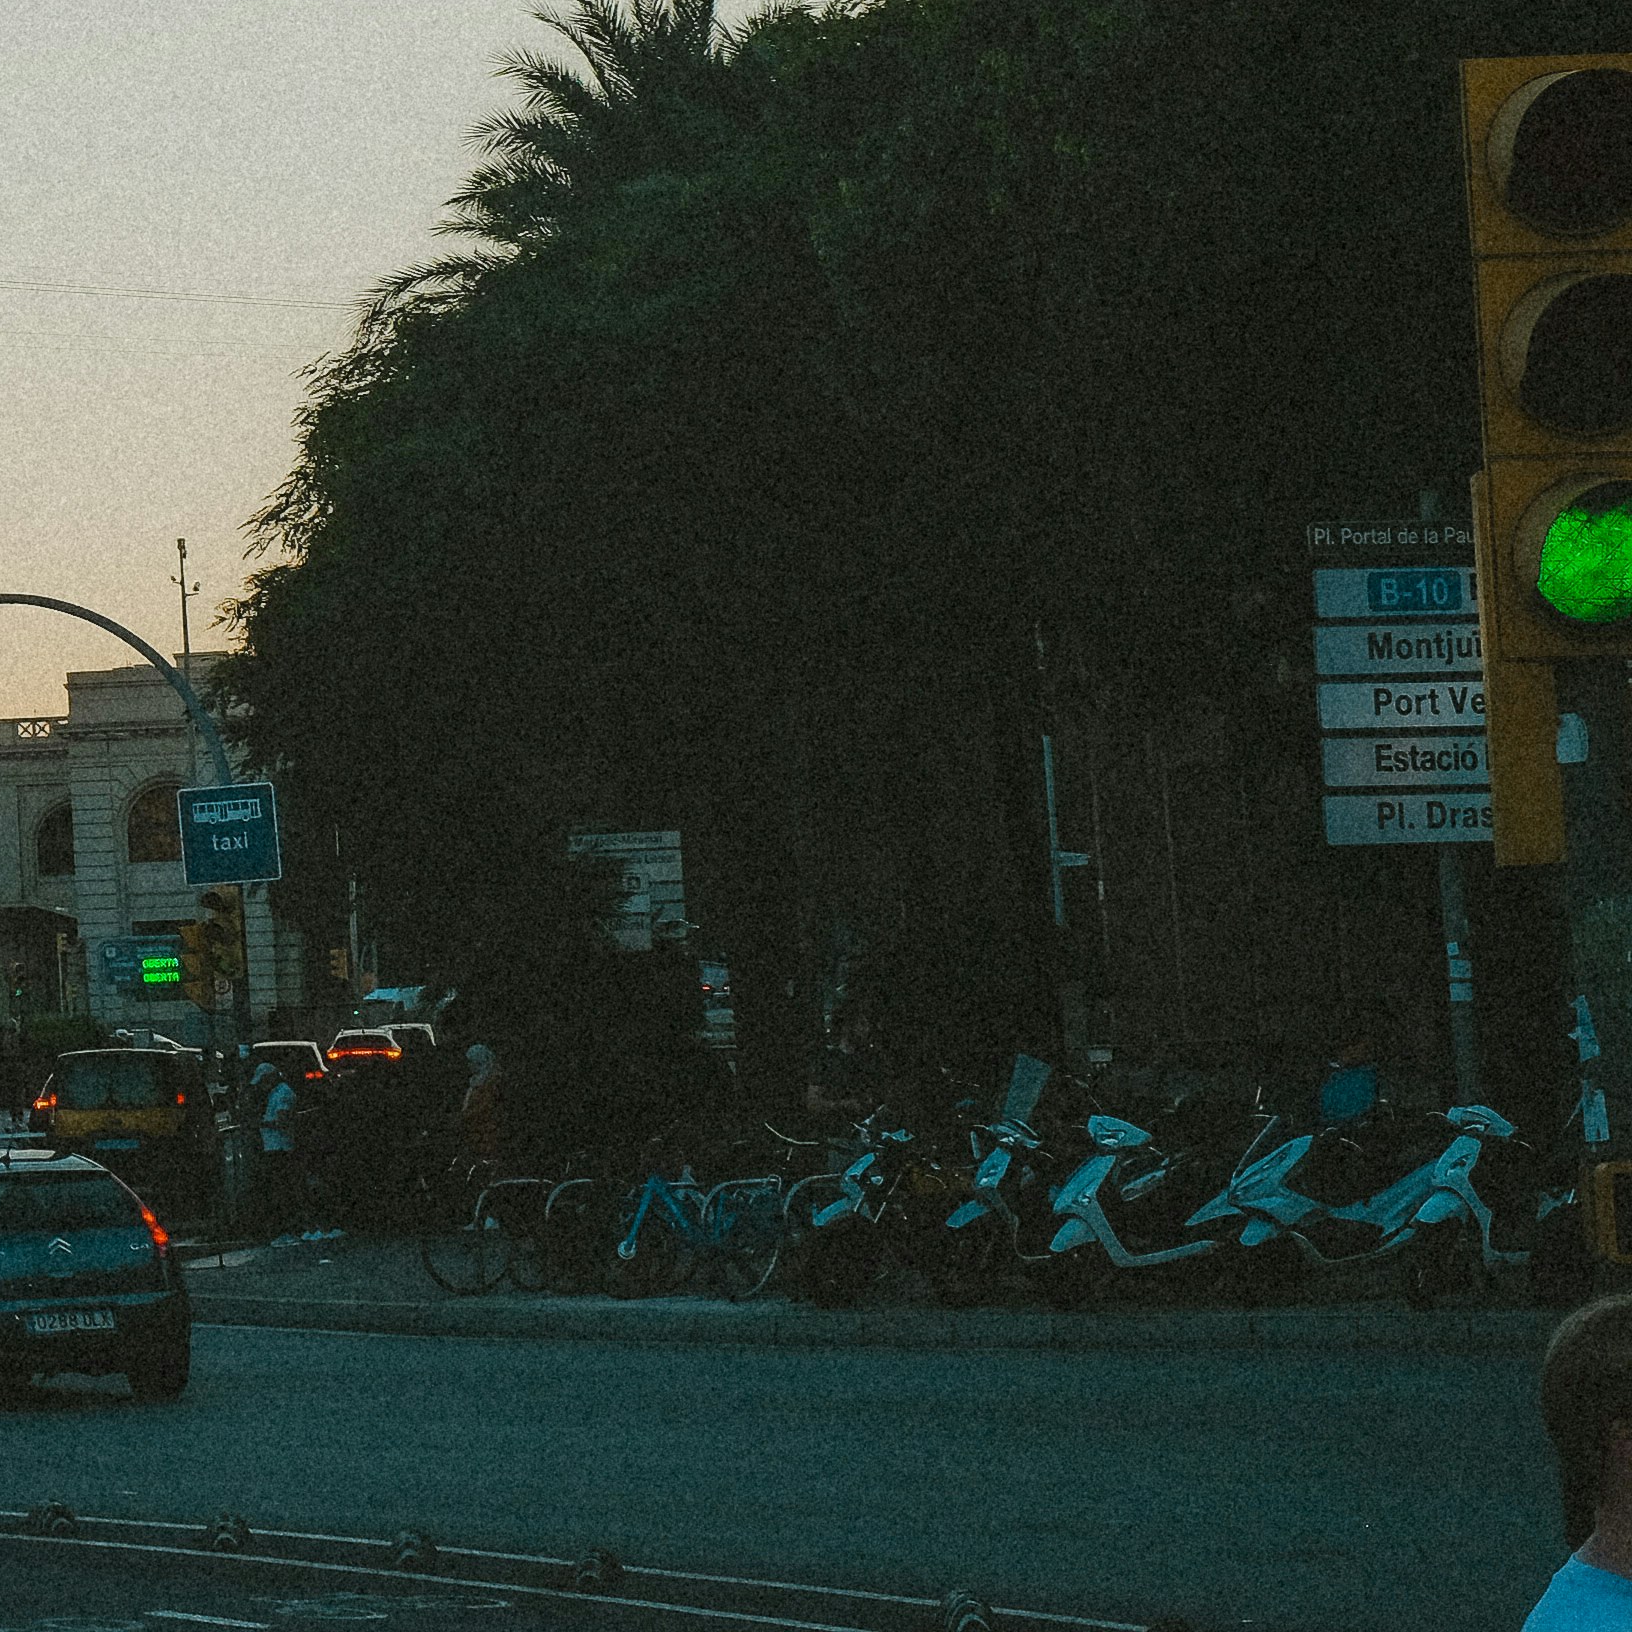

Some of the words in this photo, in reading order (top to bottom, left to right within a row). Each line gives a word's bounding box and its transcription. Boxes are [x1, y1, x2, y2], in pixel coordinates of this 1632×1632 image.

[1314, 527, 1335, 545] Pl.
[1341, 527, 1392, 545] Portal
[1397, 527, 1418, 544] de
[1424, 527, 1439, 544] la
[1443, 526, 1475, 544] Pau
[1380, 577, 1449, 605] B-10
[1373, 686, 1440, 716] Port
[1447, 686, 1486, 714] Ve
[1374, 742, 1478, 773] Estació
[1377, 801, 1415, 830] Pl.
[1426, 800, 1494, 830] Dras
[212, 830, 249, 851] taxi
